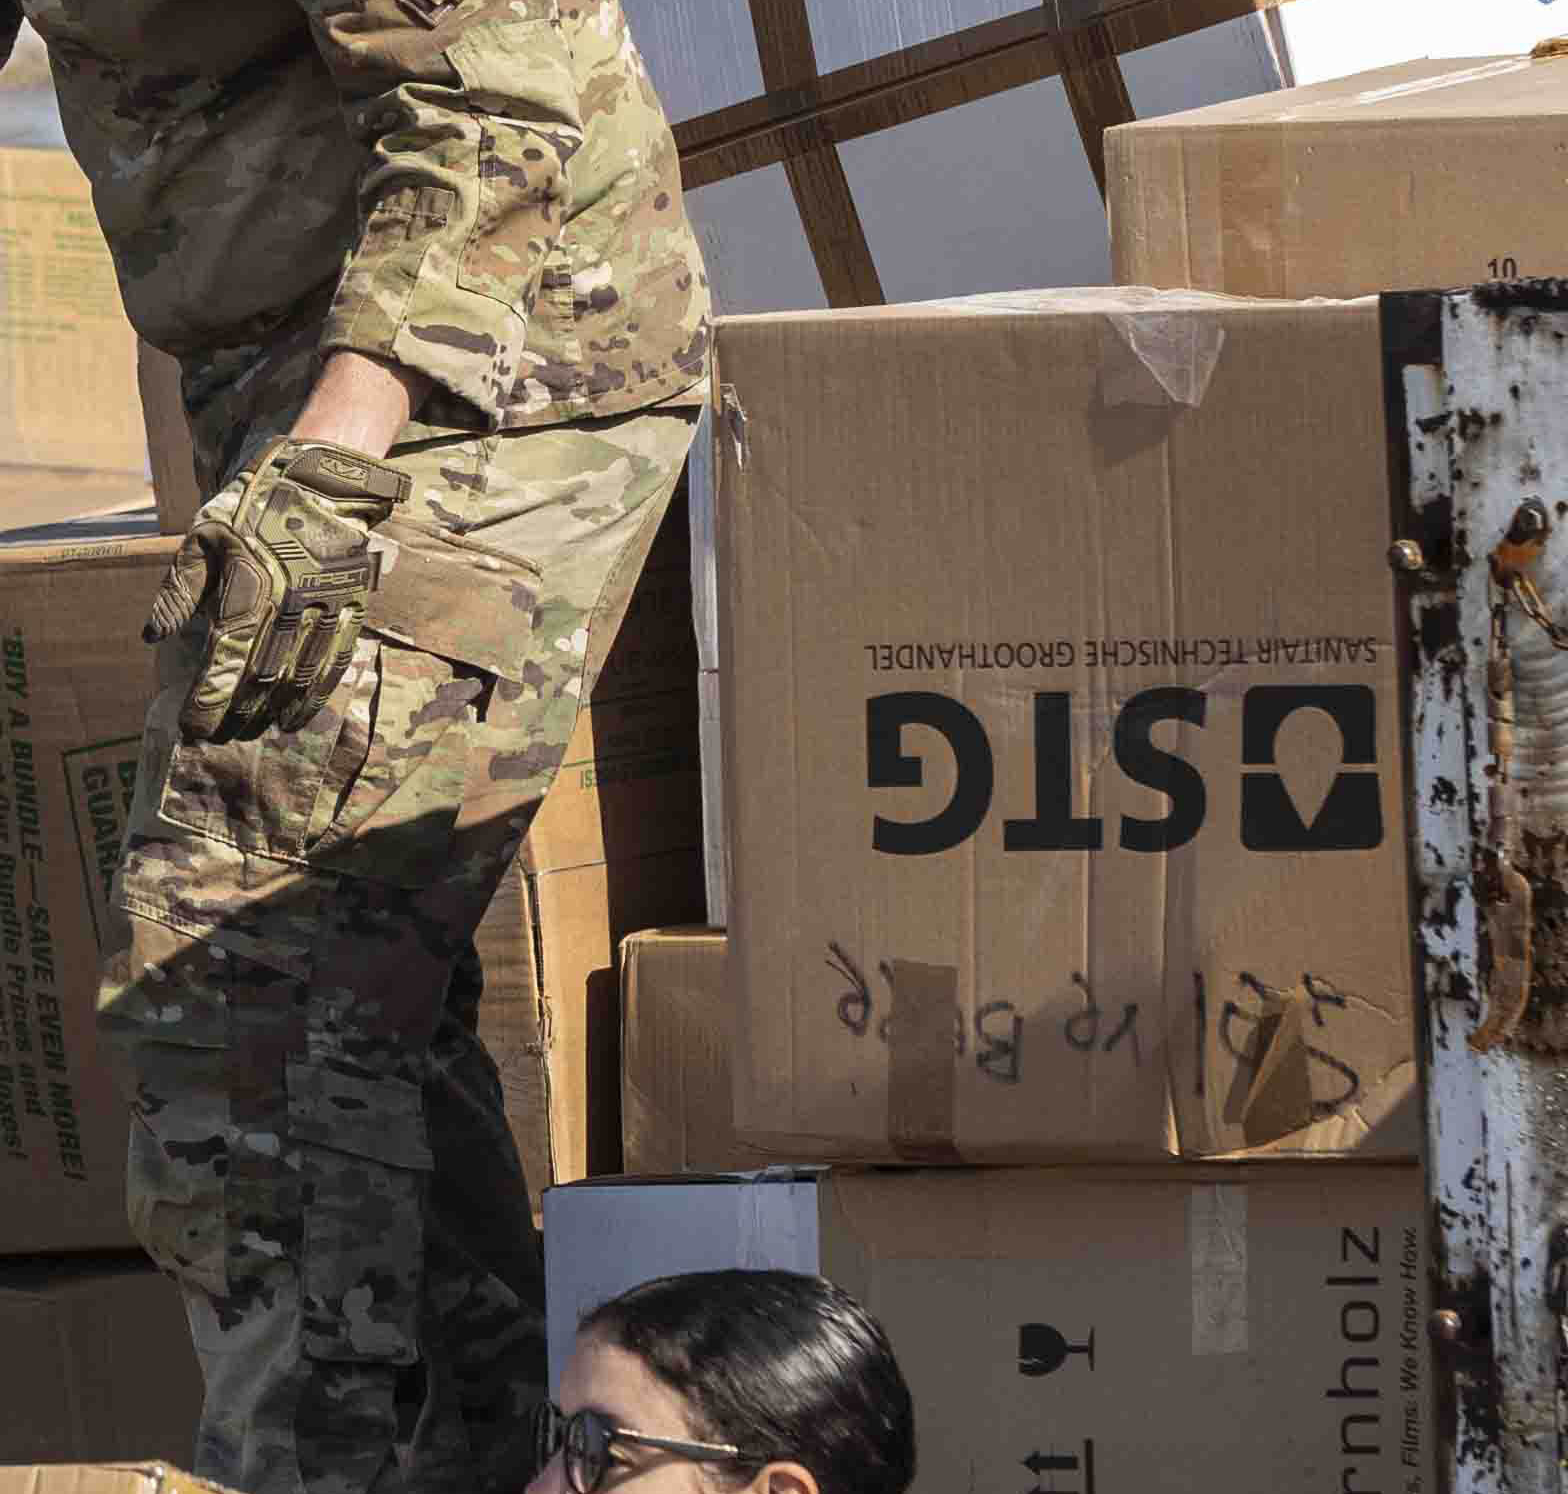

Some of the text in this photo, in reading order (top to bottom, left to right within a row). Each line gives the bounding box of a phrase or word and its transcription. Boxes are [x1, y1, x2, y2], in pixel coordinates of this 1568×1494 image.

[865, 636, 1378, 672] SANITAIR TECHNISCHE GROOTHANDEL
[8, 706, 35, 730] A
[864, 684, 1209, 856] STG
[4, 963, 33, 1054] Prices
[37, 992, 70, 1075] EVEN
[17, 1061, 45, 1115] and
[48, 1082, 90, 1181] MORE!
[1398, 1286, 1419, 1351] Know
[1398, 1356, 1419, 1393] We
